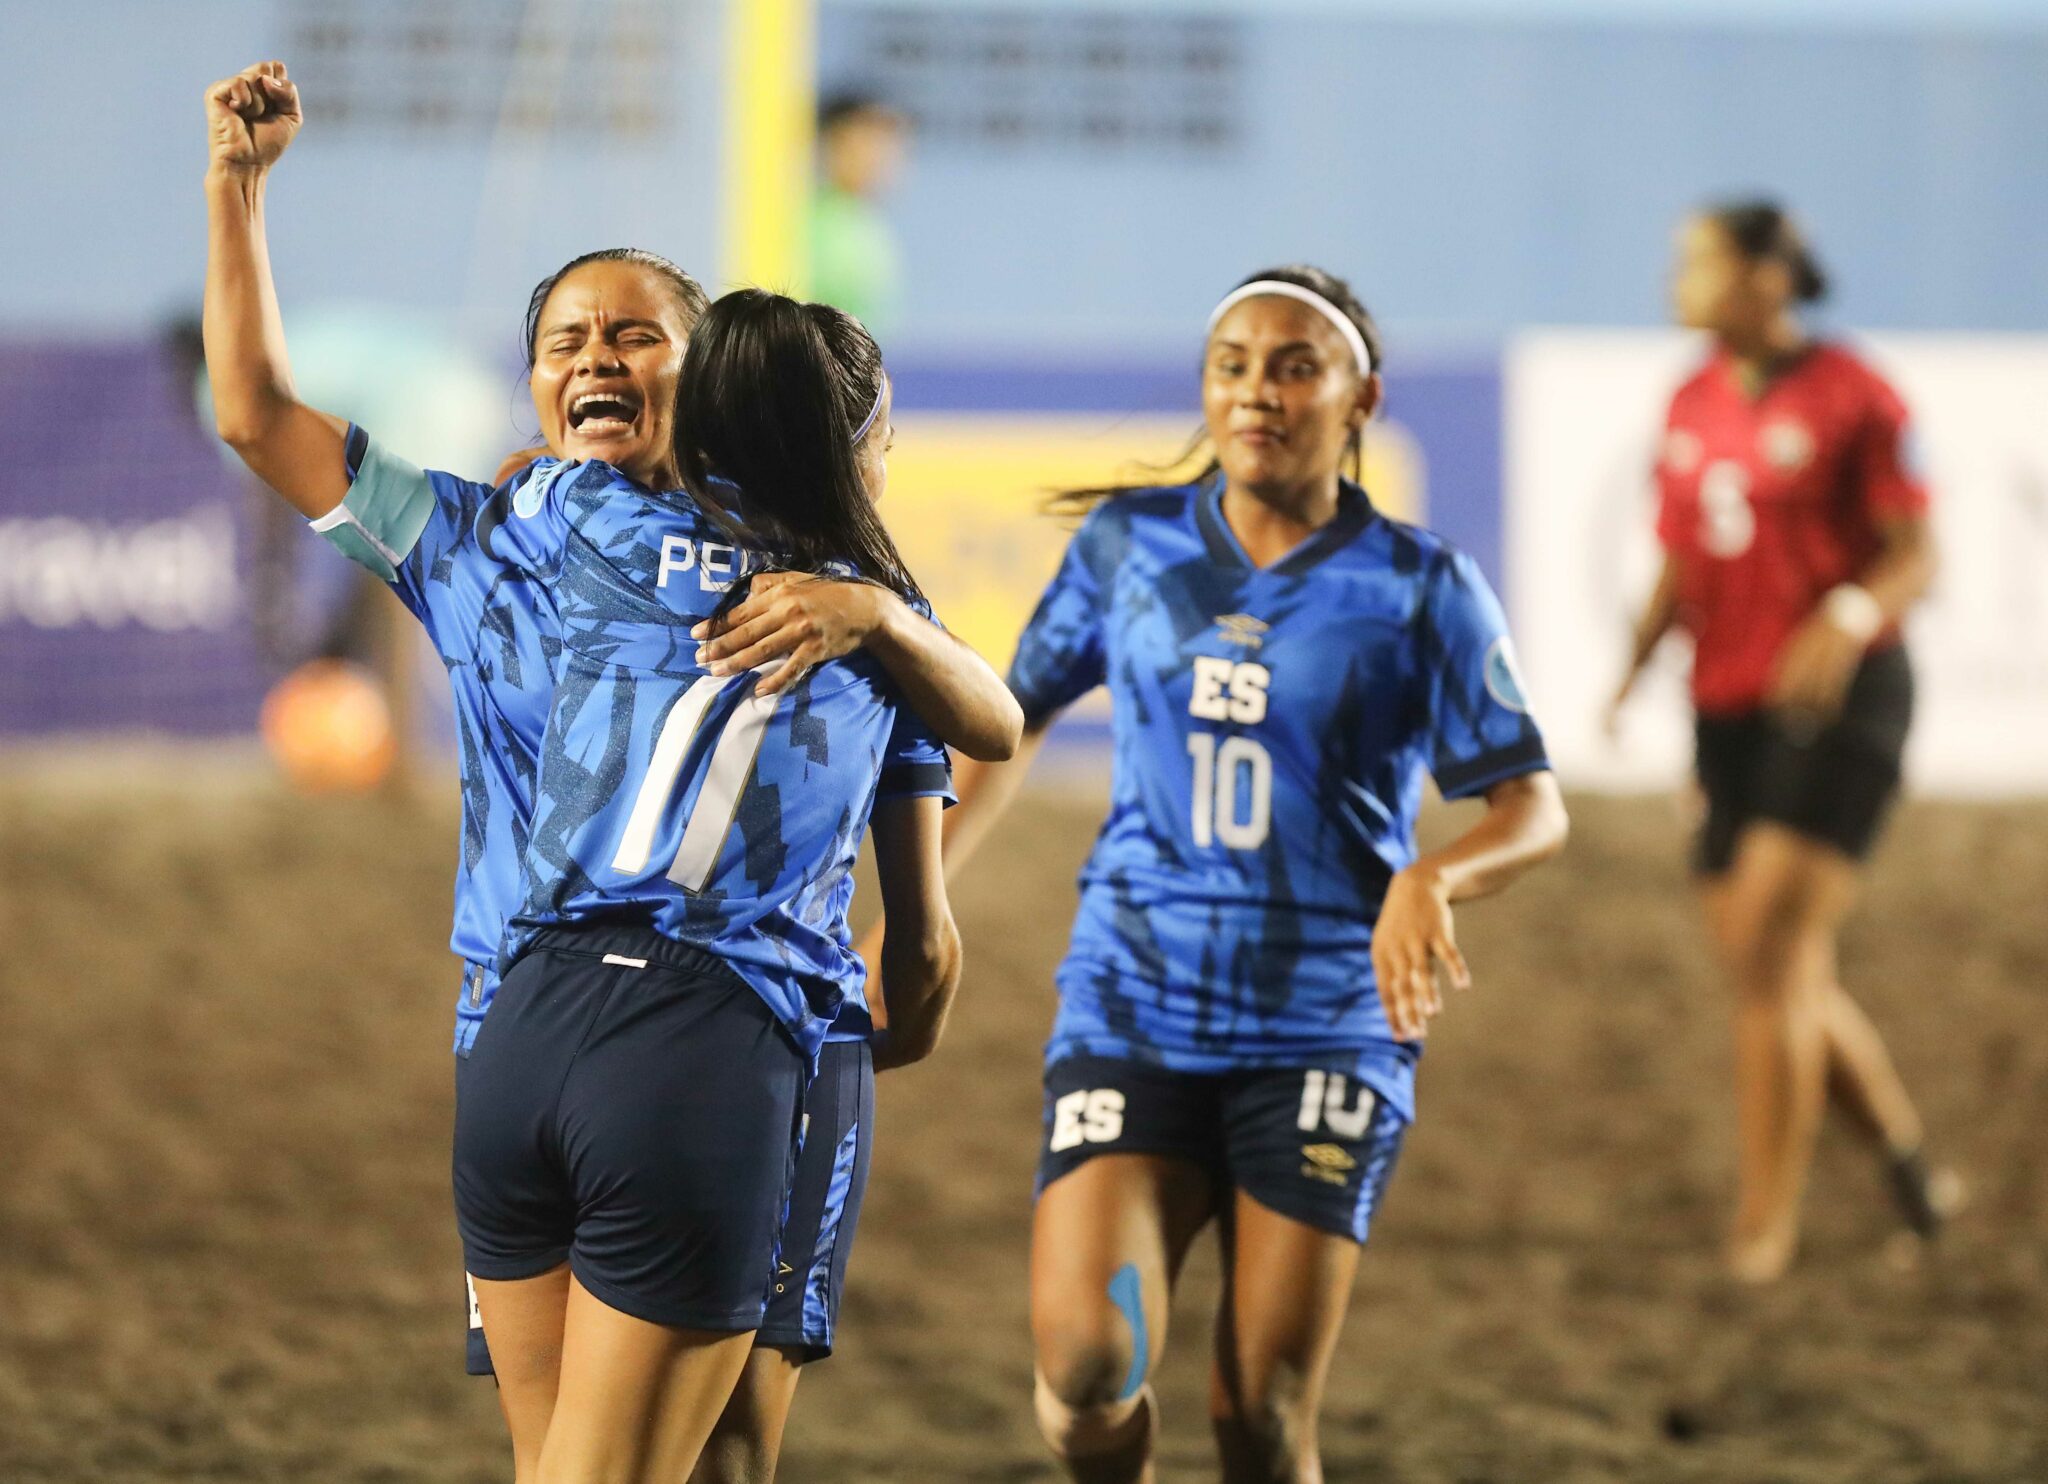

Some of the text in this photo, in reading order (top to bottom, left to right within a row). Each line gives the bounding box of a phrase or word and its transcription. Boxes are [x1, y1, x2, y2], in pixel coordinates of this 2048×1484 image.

[1189, 656, 1270, 724] ES
[1187, 732, 1272, 850] 10
[1050, 1088, 1125, 1152] ES
